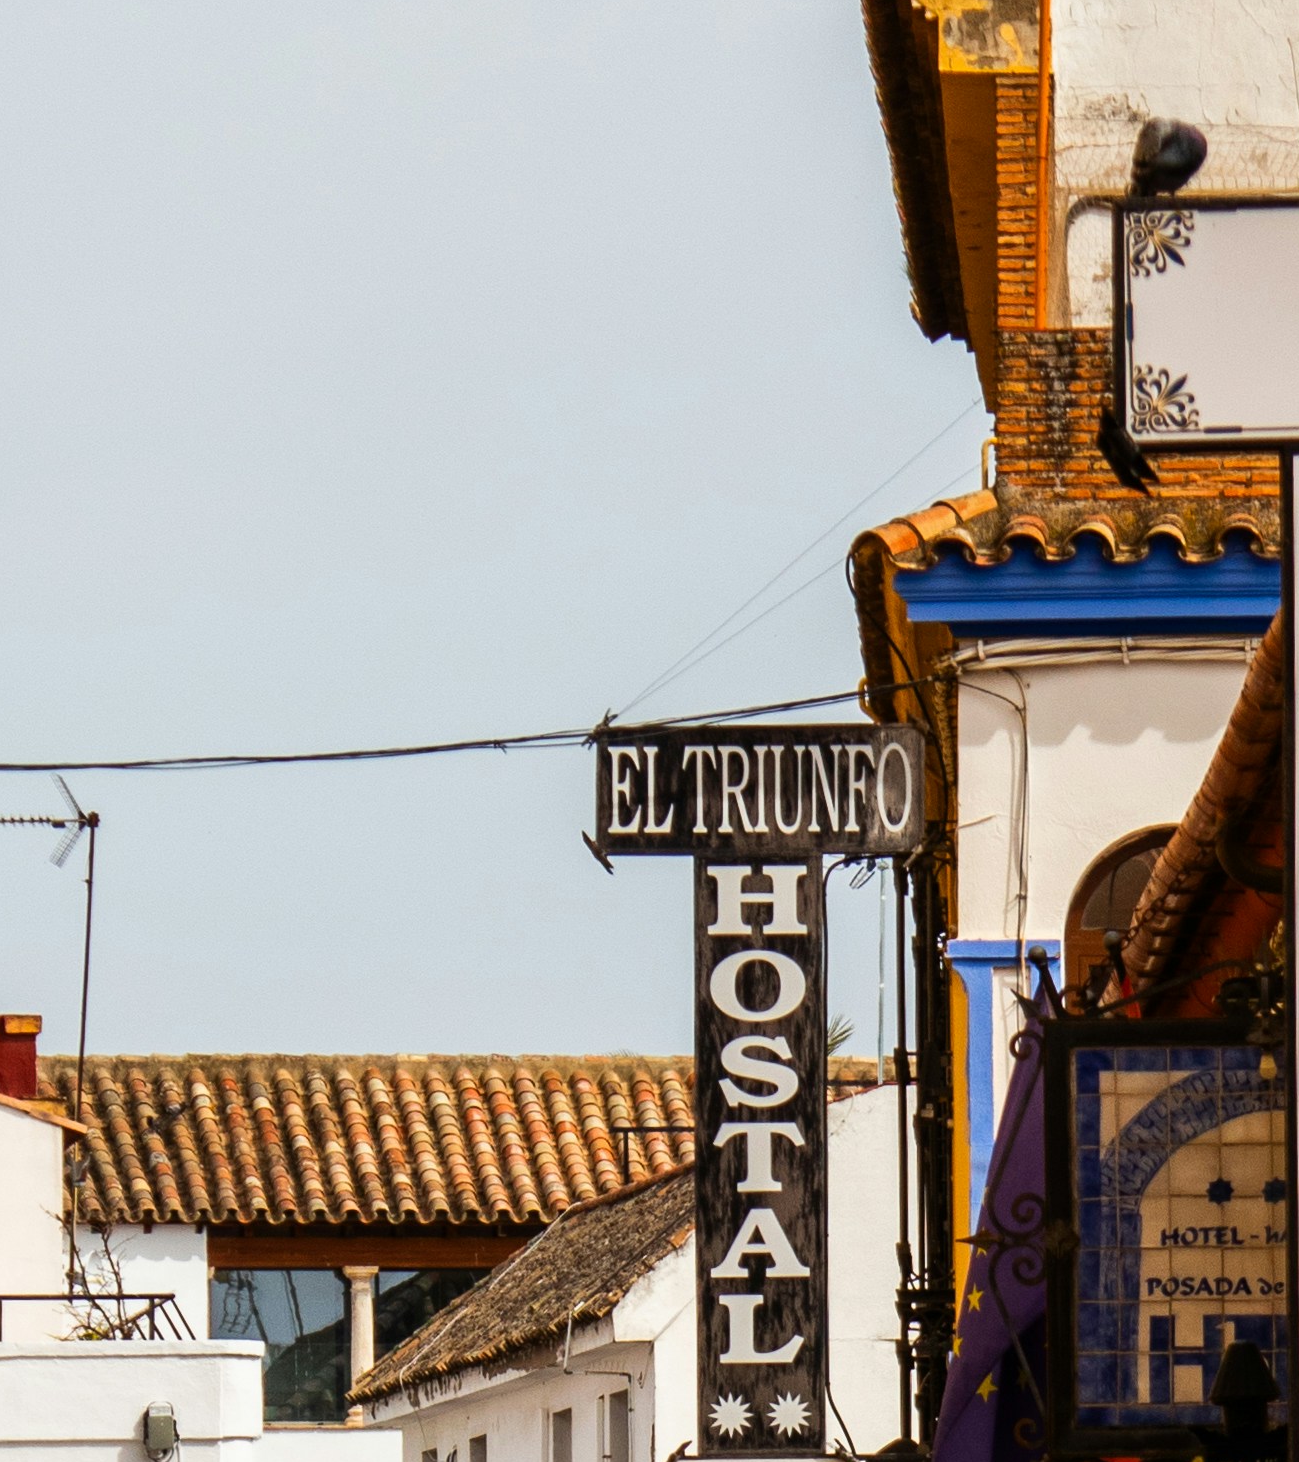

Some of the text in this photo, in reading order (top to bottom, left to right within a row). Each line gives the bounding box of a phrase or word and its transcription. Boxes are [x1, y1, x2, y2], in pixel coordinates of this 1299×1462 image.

[608, 742, 913, 836] EL TRIUNFO
[707, 864, 810, 1366] HOSTAL
[1161, 1226, 1244, 1246] HOTEL
[1146, 1276, 1285, 1296] POSADA de
